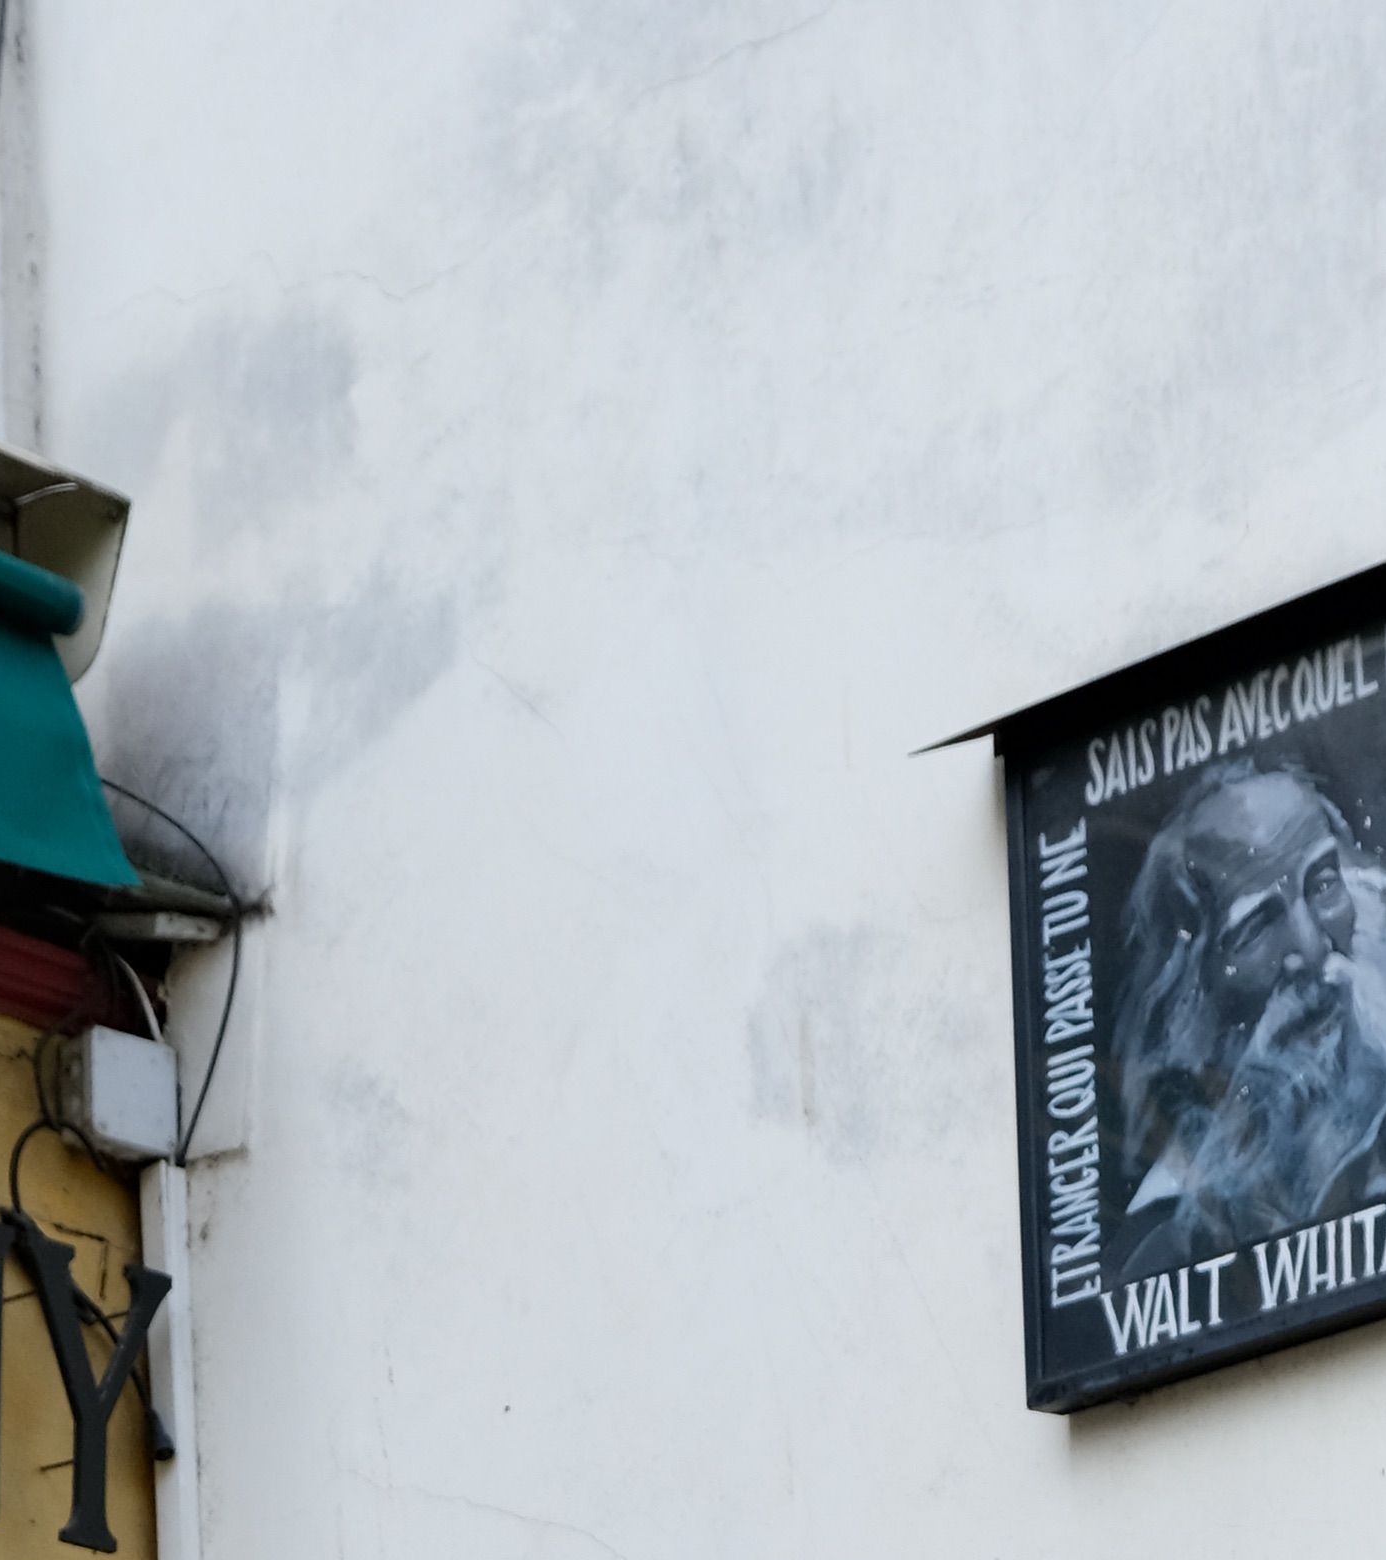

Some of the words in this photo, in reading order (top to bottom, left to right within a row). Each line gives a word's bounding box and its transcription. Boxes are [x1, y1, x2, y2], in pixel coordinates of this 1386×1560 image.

[1084, 718, 1157, 806] SAIS
[1162, 695, 1212, 775] PAS
[1217, 663, 1290, 754] AVEC
[1291, 635, 1378, 723] QUEL
[1039, 817, 1087, 889] NE
[1043, 889, 1089, 943] TU
[1044, 939, 1095, 1043] PASSE
[1047, 1045, 1096, 1119] QUI
[1048, 1115, 1103, 1308] ETRANGER
[1101, 1252, 1237, 1356] WALT
